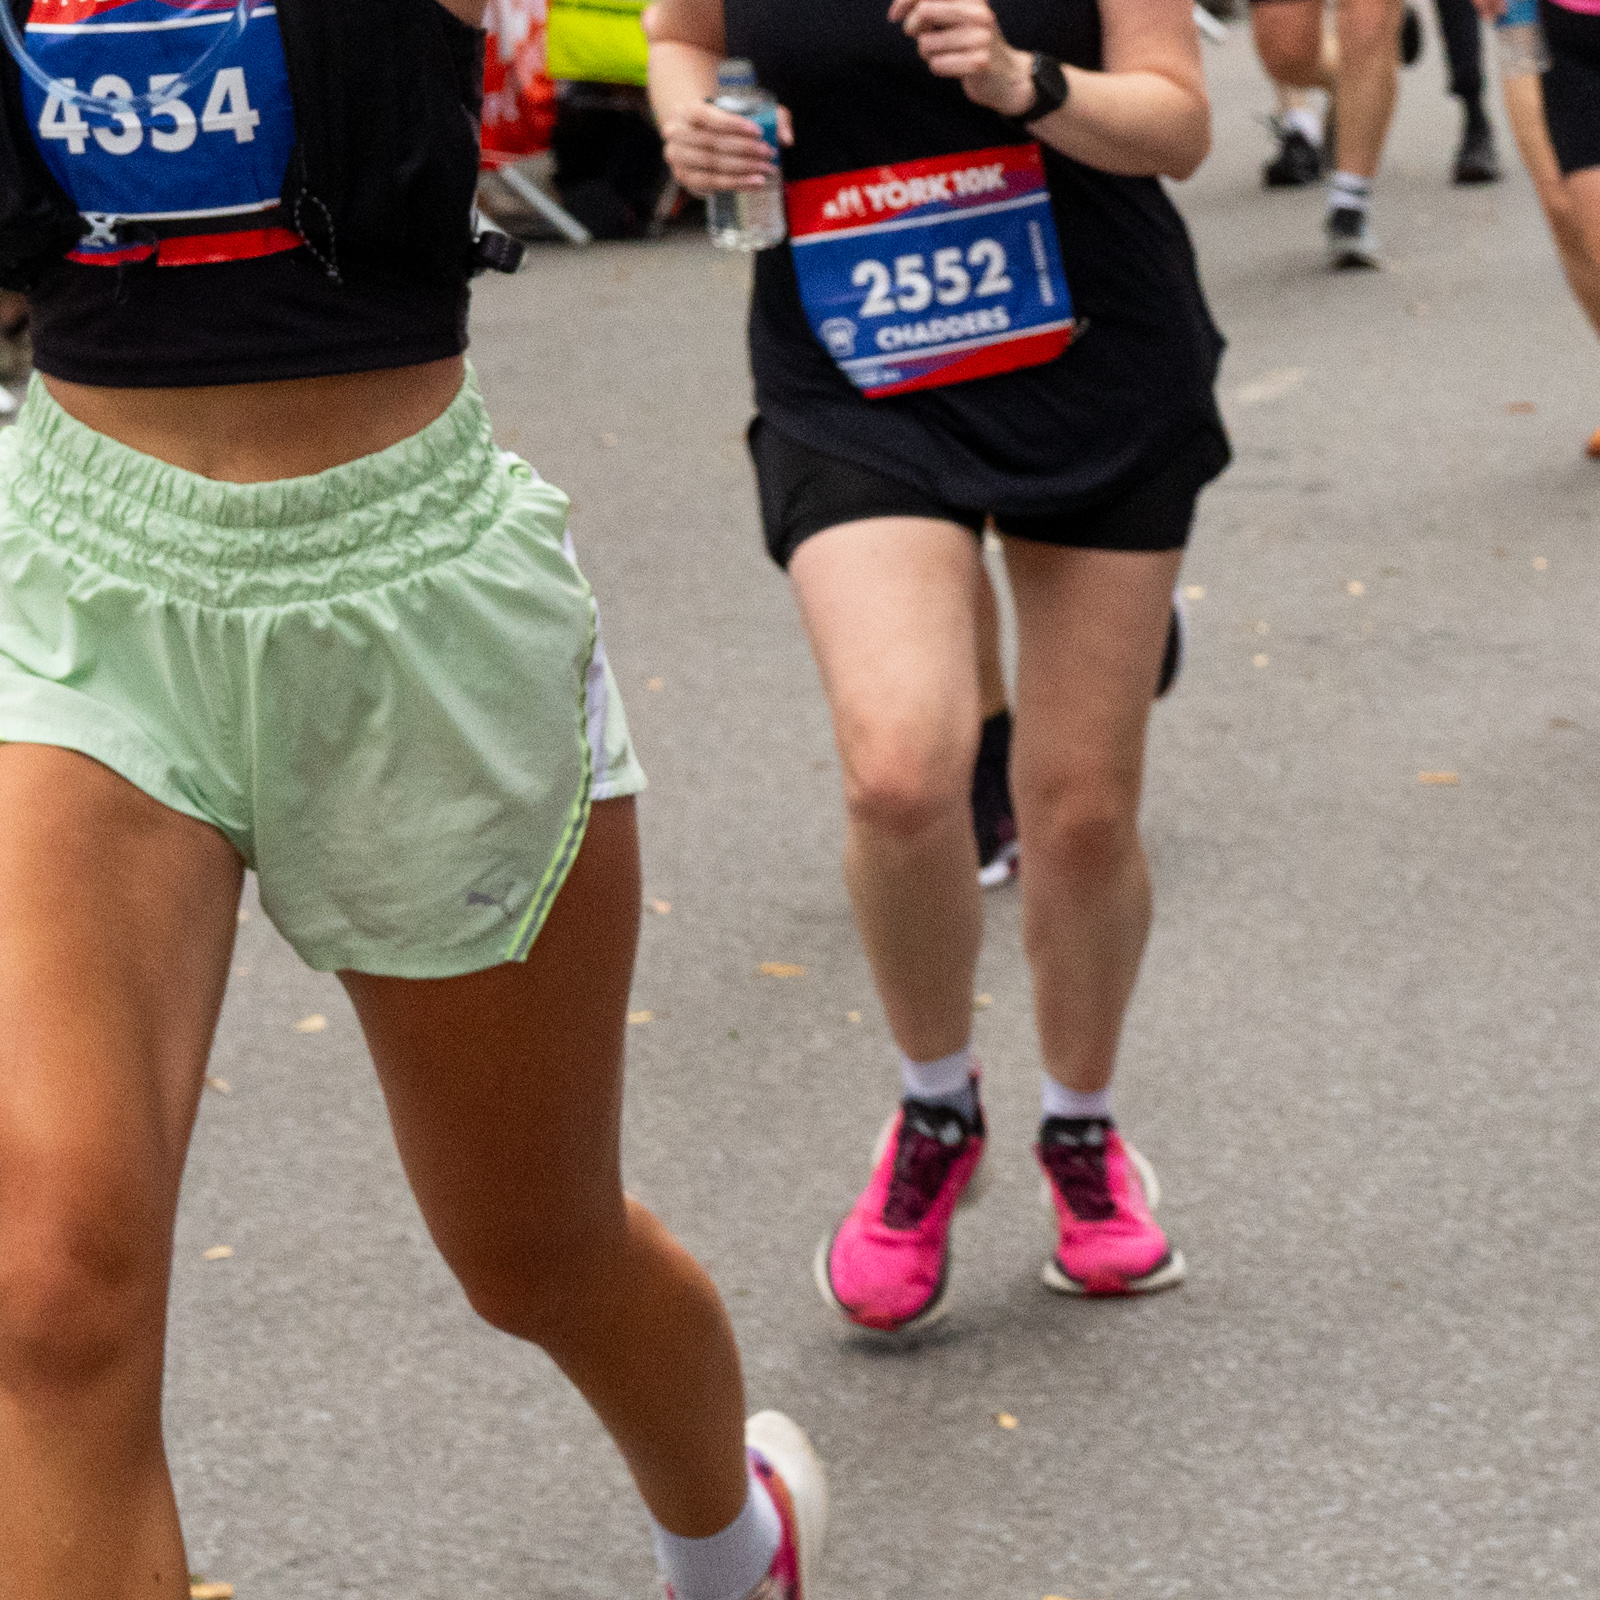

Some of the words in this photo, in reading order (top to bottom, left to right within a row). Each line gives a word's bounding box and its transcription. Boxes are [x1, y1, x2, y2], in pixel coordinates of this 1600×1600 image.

[37, 66, 261, 157] 4354
[864, 173, 951, 213] YORK
[951, 162, 1008, 195] 10K
[851, 238, 1013, 319] 2552
